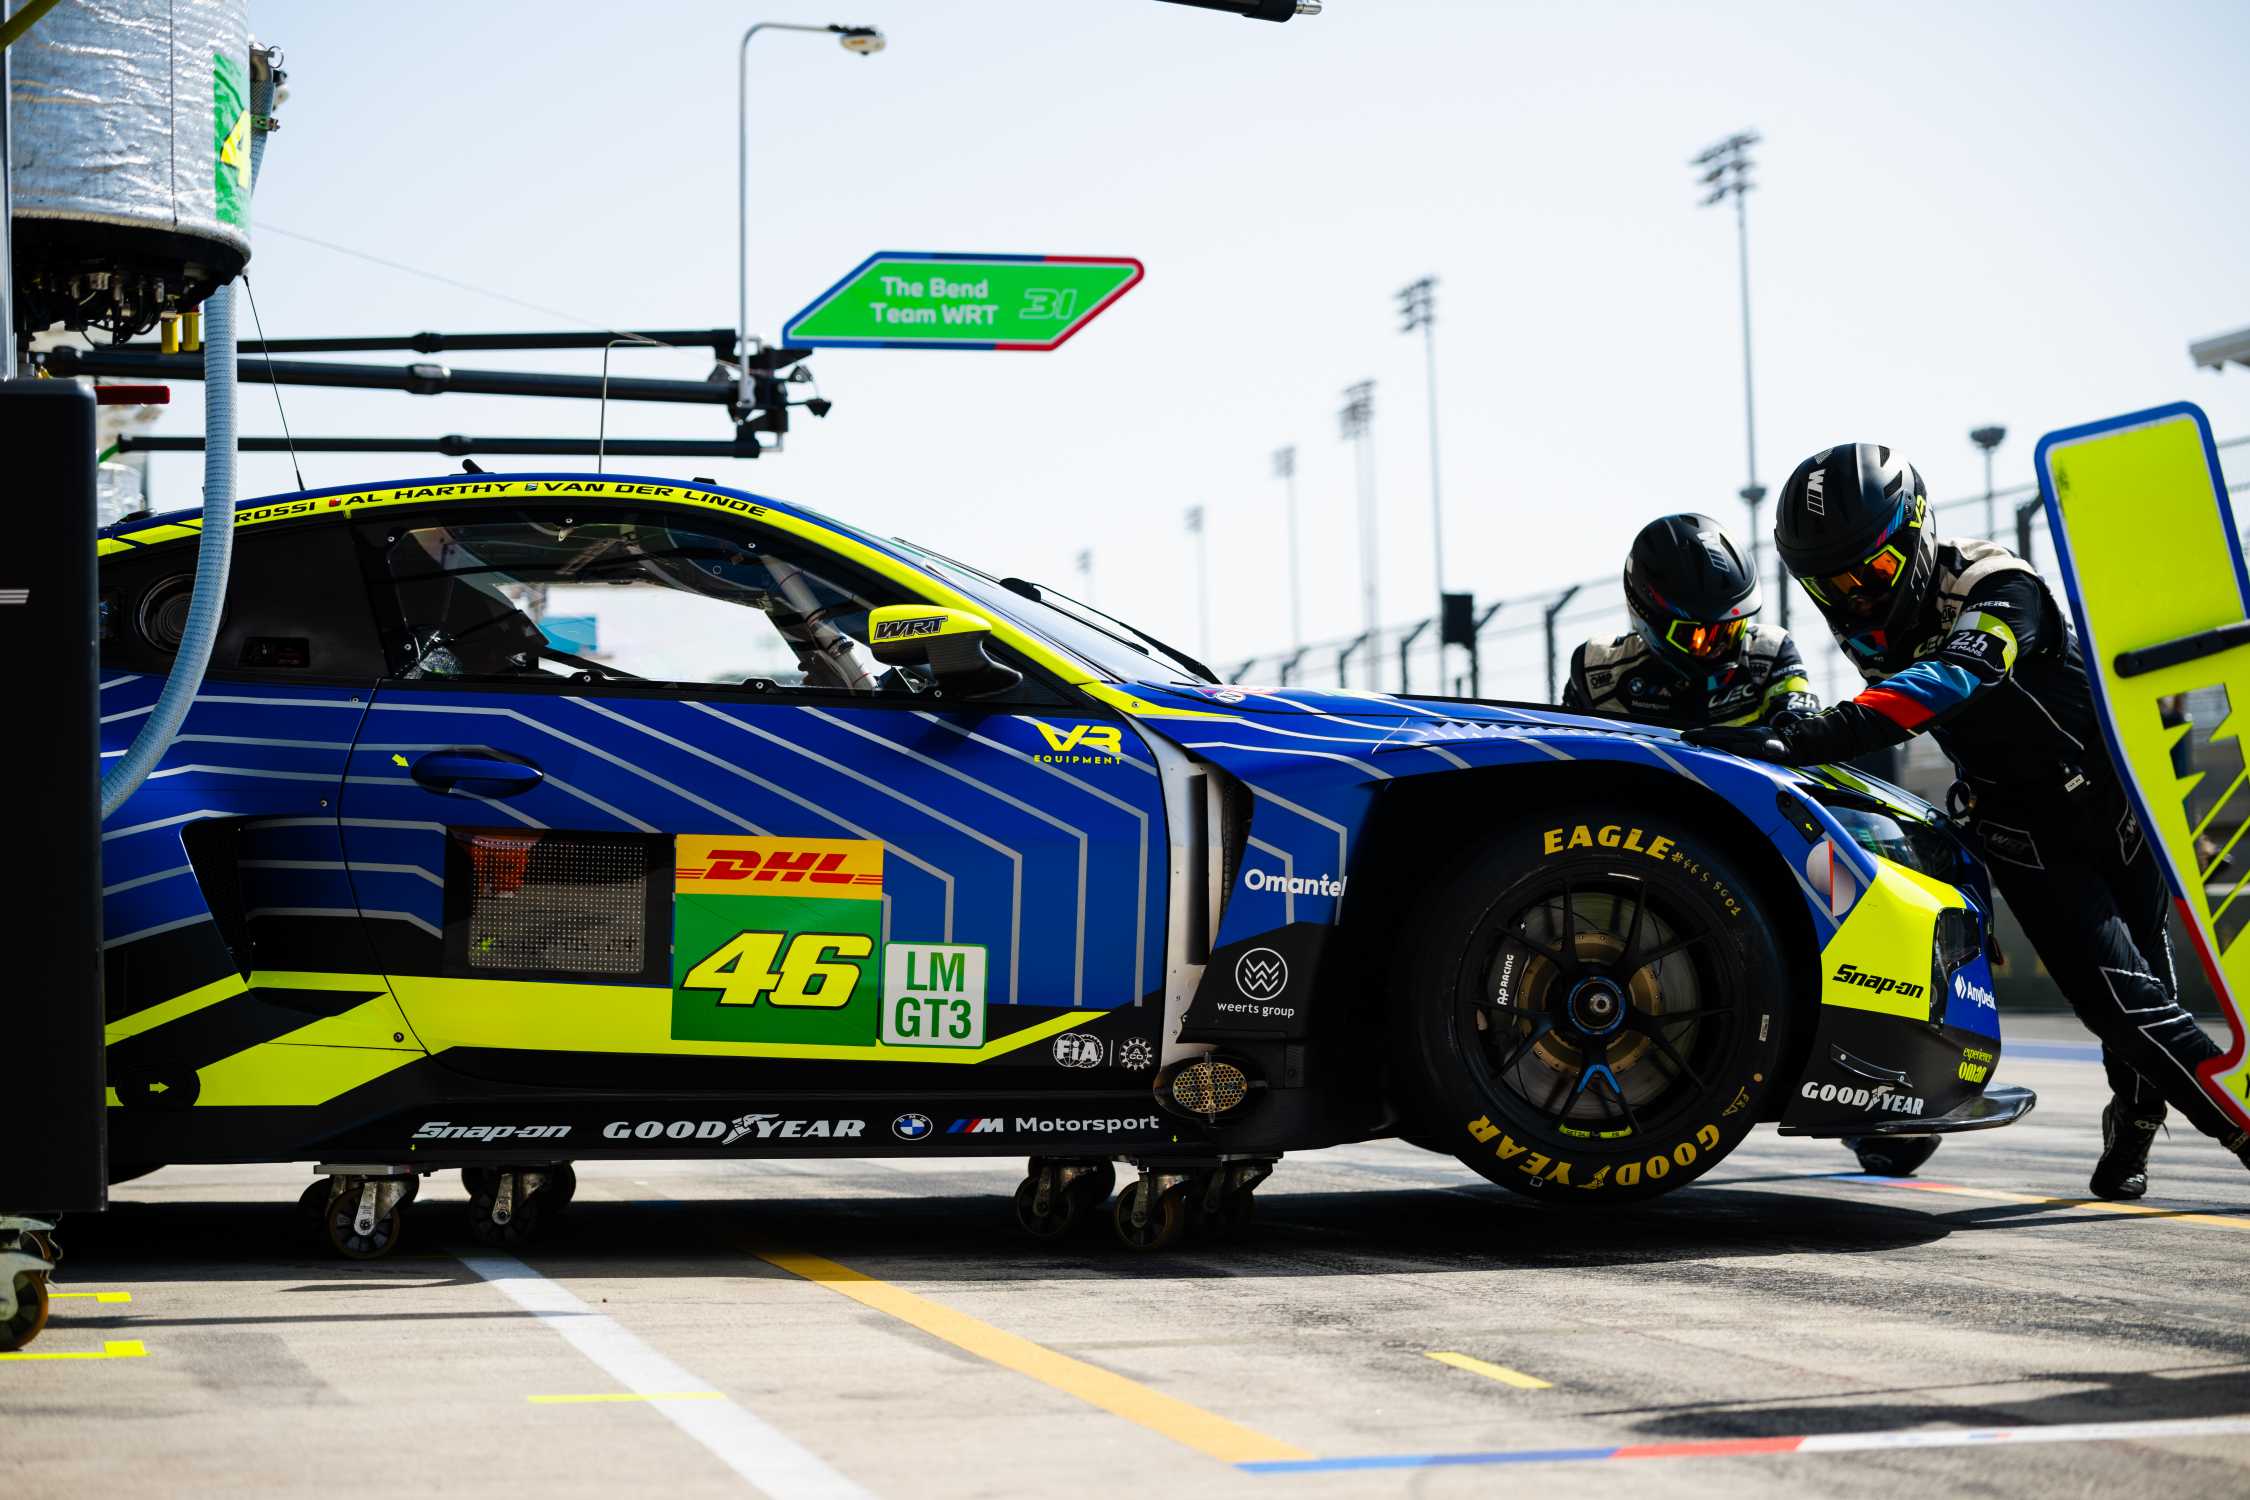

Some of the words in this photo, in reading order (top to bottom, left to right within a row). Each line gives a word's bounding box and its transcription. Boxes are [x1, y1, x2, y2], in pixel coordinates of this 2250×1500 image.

[881, 276, 923, 298] The
[930, 277, 988, 300] Bend
[870, 302, 936, 325] Team
[940, 304, 998, 326] WRT
[1019, 288, 1077, 321] 31
[234, 501, 316, 523] ROSSI
[345, 493, 383, 506] AL
[394, 483, 513, 500] HARTHY
[543, 482, 605, 492] VAN
[614, 484, 675, 497] DER
[683, 491, 768, 517] LINDE
[874, 616, 948, 640] WRT
[1034, 754, 1122, 765] EQUIPMENT
[1544, 824, 1676, 861] EAGLE
[703, 850, 858, 884] DHL
[1244, 868, 1348, 897] Omantel
[679, 929, 874, 1010] 46
[906, 951, 966, 993] LM
[1500, 954, 1514, 988] RACING
[1833, 963, 1924, 999] Snap-on
[1967, 981, 1996, 1010] AnyDesk
[895, 997, 972, 1040] GT3
[1217, 1002, 1259, 1014] weerts
[1262, 1006, 1295, 1019] group
[1963, 1047, 1993, 1062] experience
[411, 1121, 572, 1142] Snap-on
[1016, 1115, 1159, 1134] Motorsport
